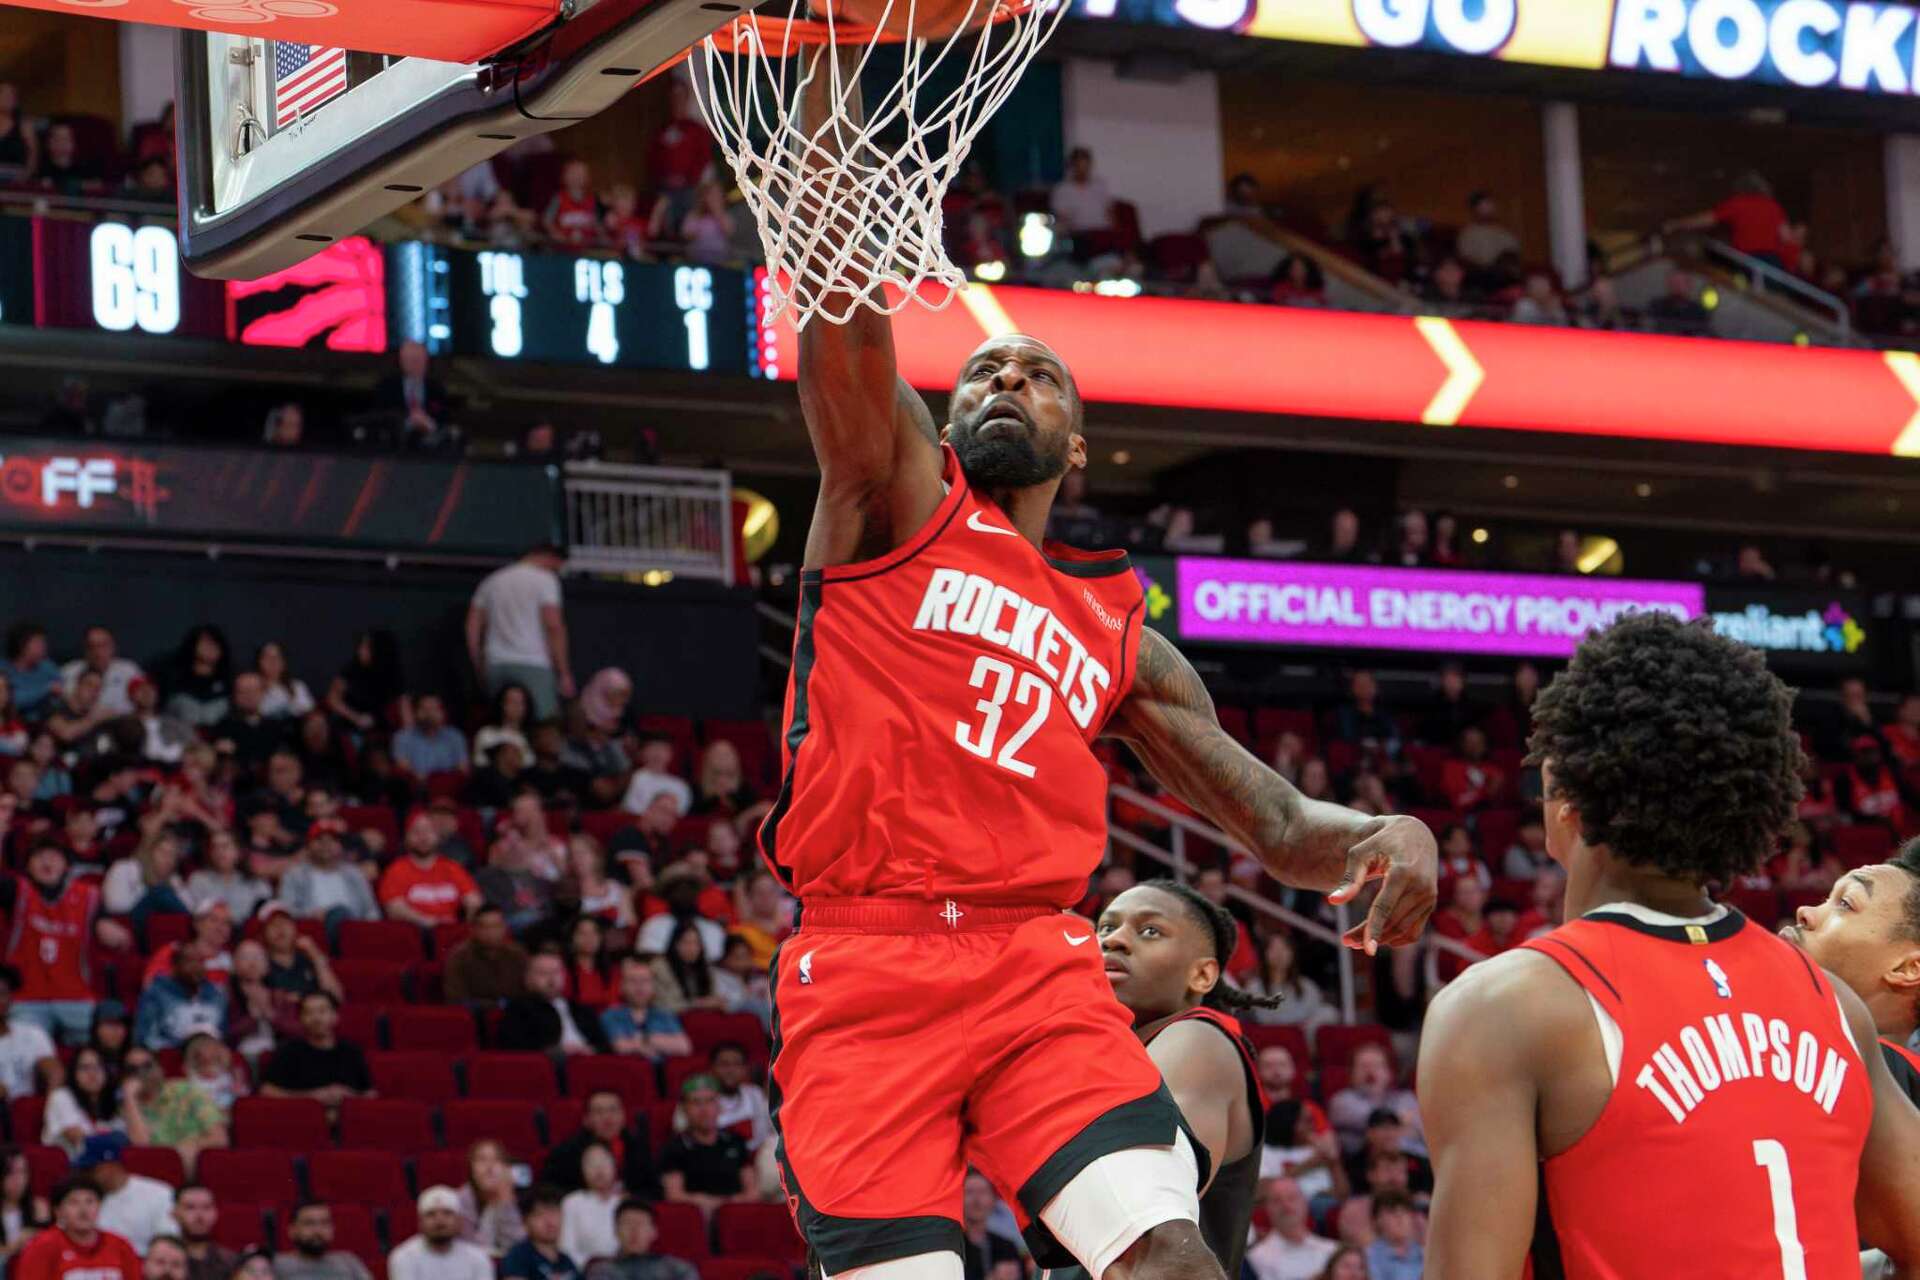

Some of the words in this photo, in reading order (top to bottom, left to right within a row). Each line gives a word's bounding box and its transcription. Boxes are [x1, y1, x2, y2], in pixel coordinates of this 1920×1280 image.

[1353, 0, 1519, 57] GO
[1609, 0, 1920, 95] ROCK
[91, 222, 180, 334] 69
[574, 258, 624, 305] FLS
[587, 301, 619, 364] 4
[683, 307, 709, 370] 1
[912, 567, 1111, 729] ROCKETS
[1194, 579, 1367, 628] OFFICIAL
[1369, 588, 1512, 635] ENERGY
[954, 655, 1052, 779] 32
[1635, 1012, 1849, 1125] THOMPSON
[1752, 1138, 1808, 1280] 1
